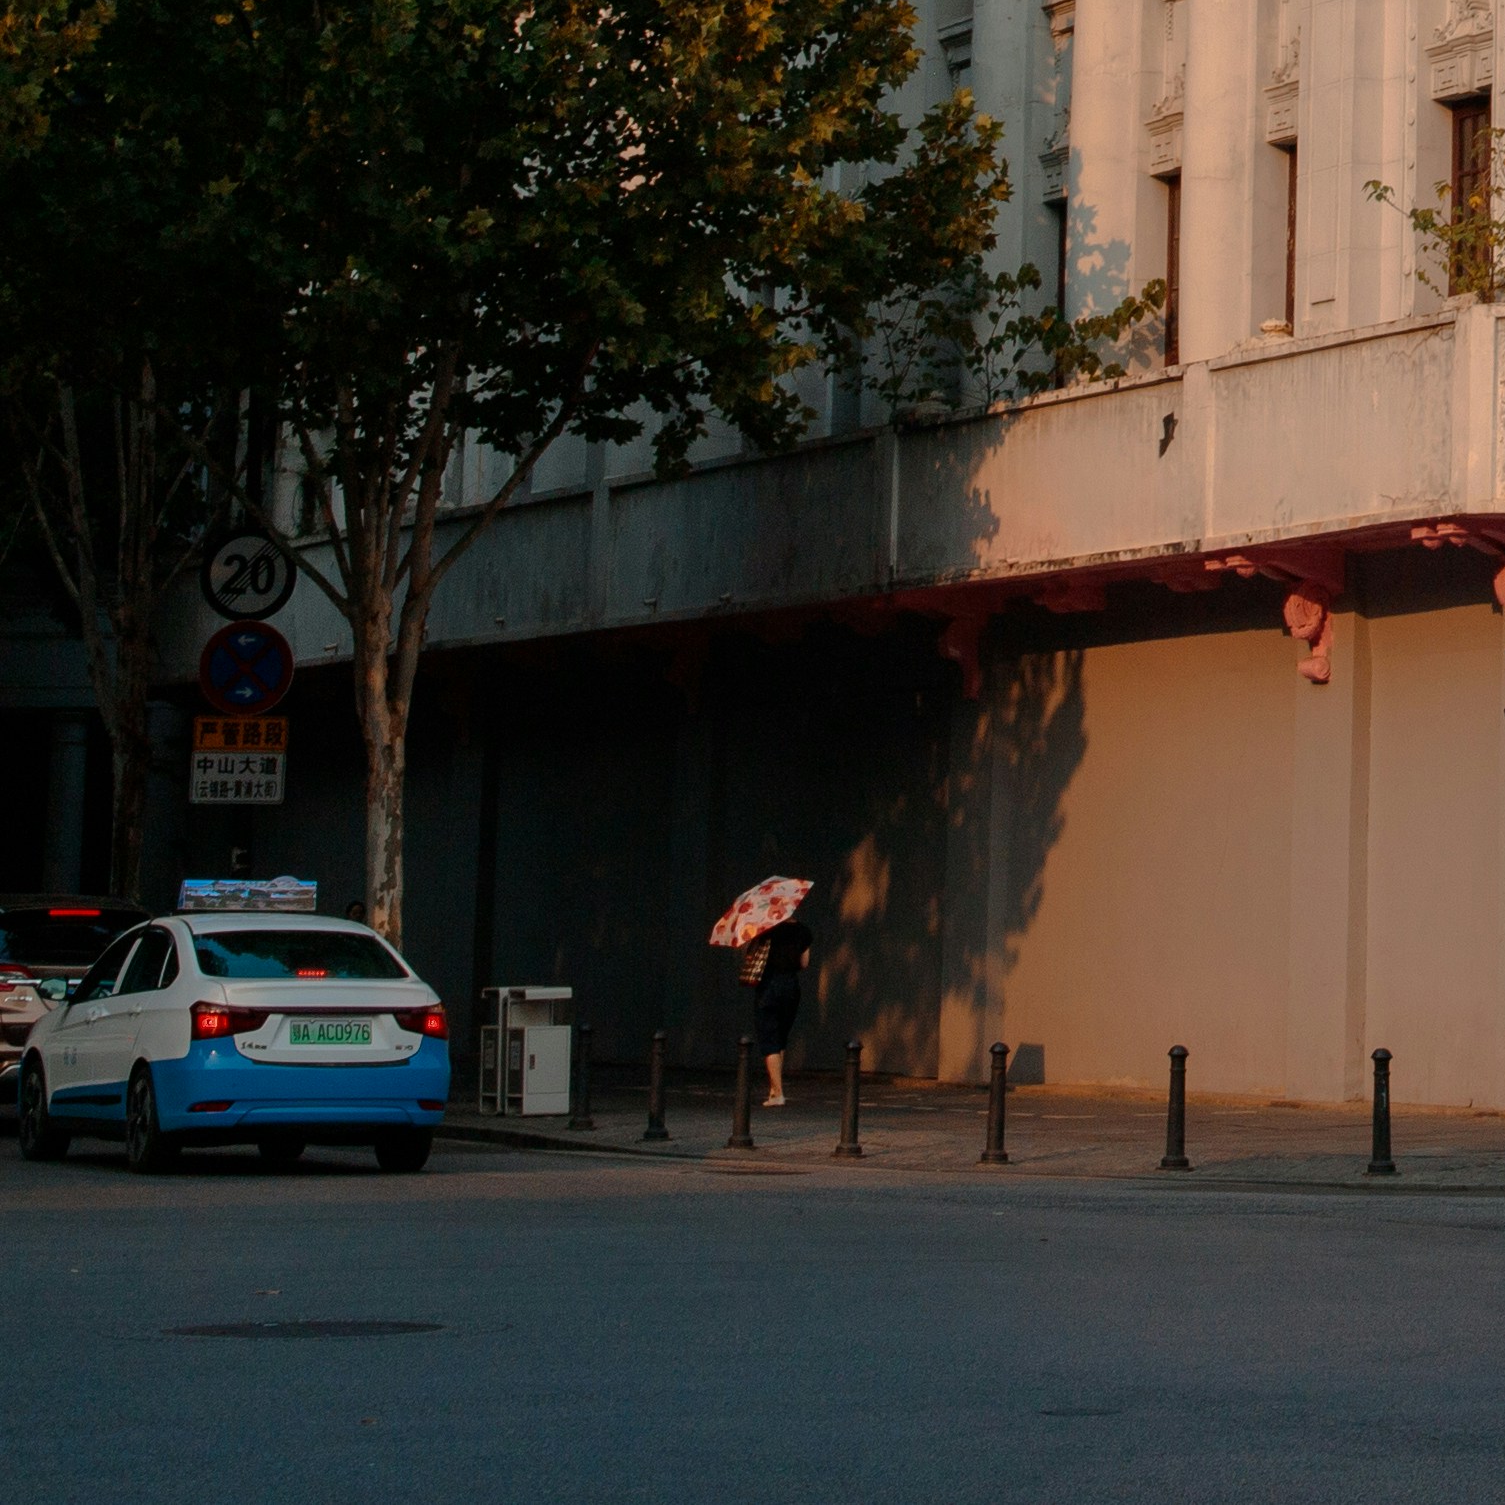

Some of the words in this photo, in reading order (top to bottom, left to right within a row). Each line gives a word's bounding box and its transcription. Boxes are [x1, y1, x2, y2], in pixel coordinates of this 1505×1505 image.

[224, 555, 275, 595] 20
[200, 721, 284, 746] 严管路段
[196, 756, 278, 776] 中山大道
[318, 1023, 370, 1041] AC0976
